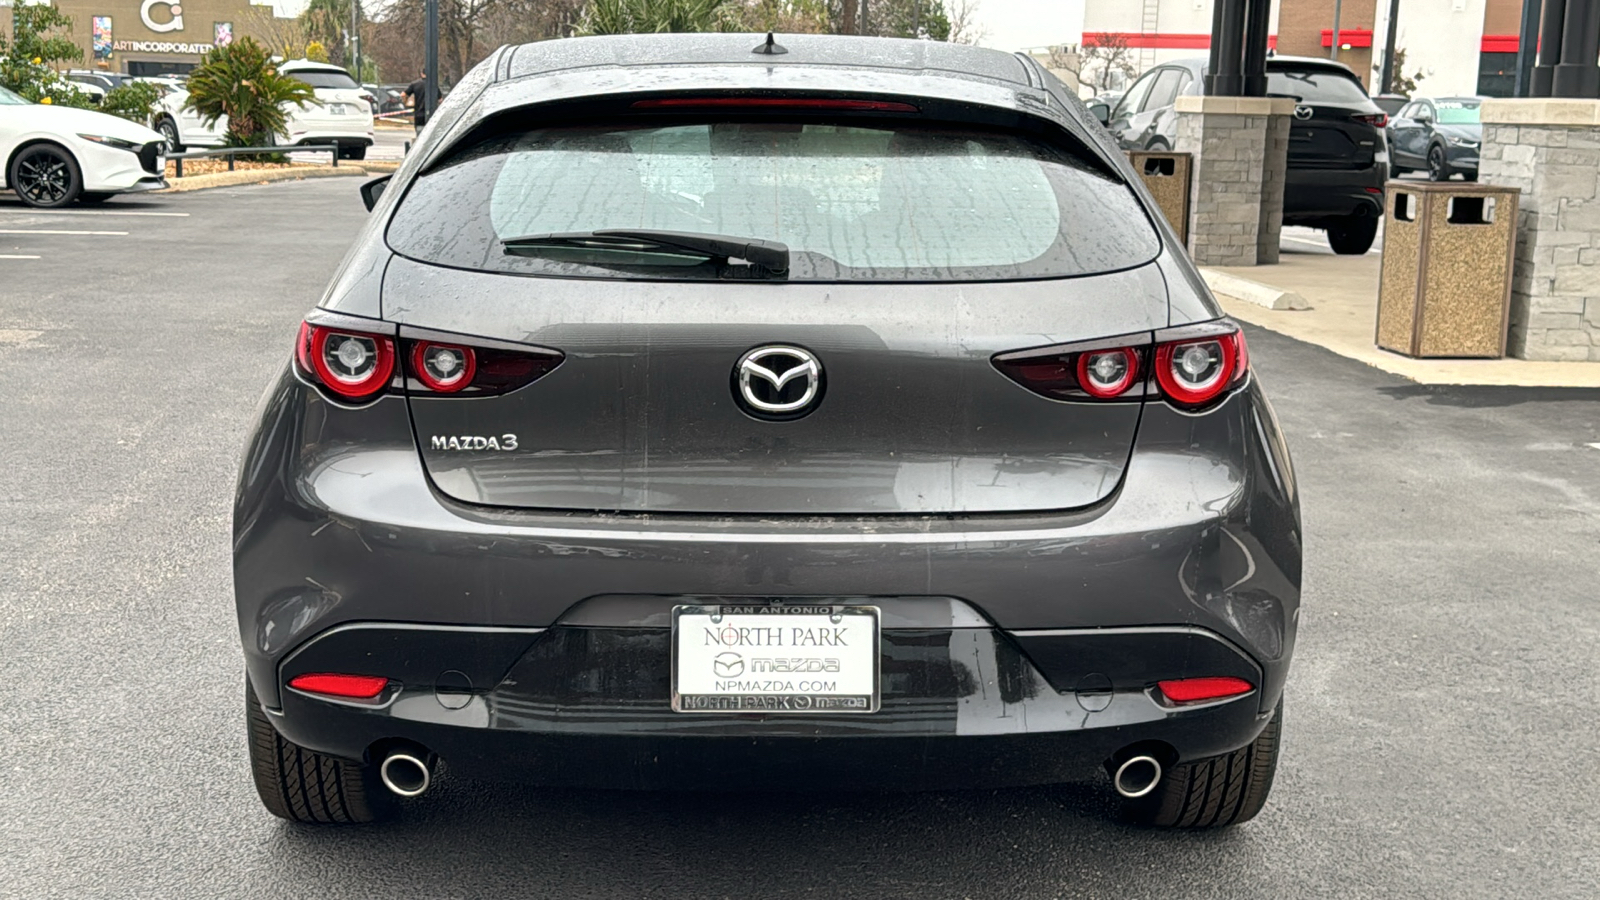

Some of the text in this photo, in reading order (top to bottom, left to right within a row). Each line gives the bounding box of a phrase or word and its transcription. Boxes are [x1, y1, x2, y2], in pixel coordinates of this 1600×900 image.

[723, 606, 830, 614] SAN ANTONIO
[704, 627, 849, 647] NORTH PARK
[751, 657, 840, 673] mazda
[715, 680, 836, 692] NPMAZDA.COM
[684, 696, 742, 709] NORTH
[747, 696, 790, 709] PARK
